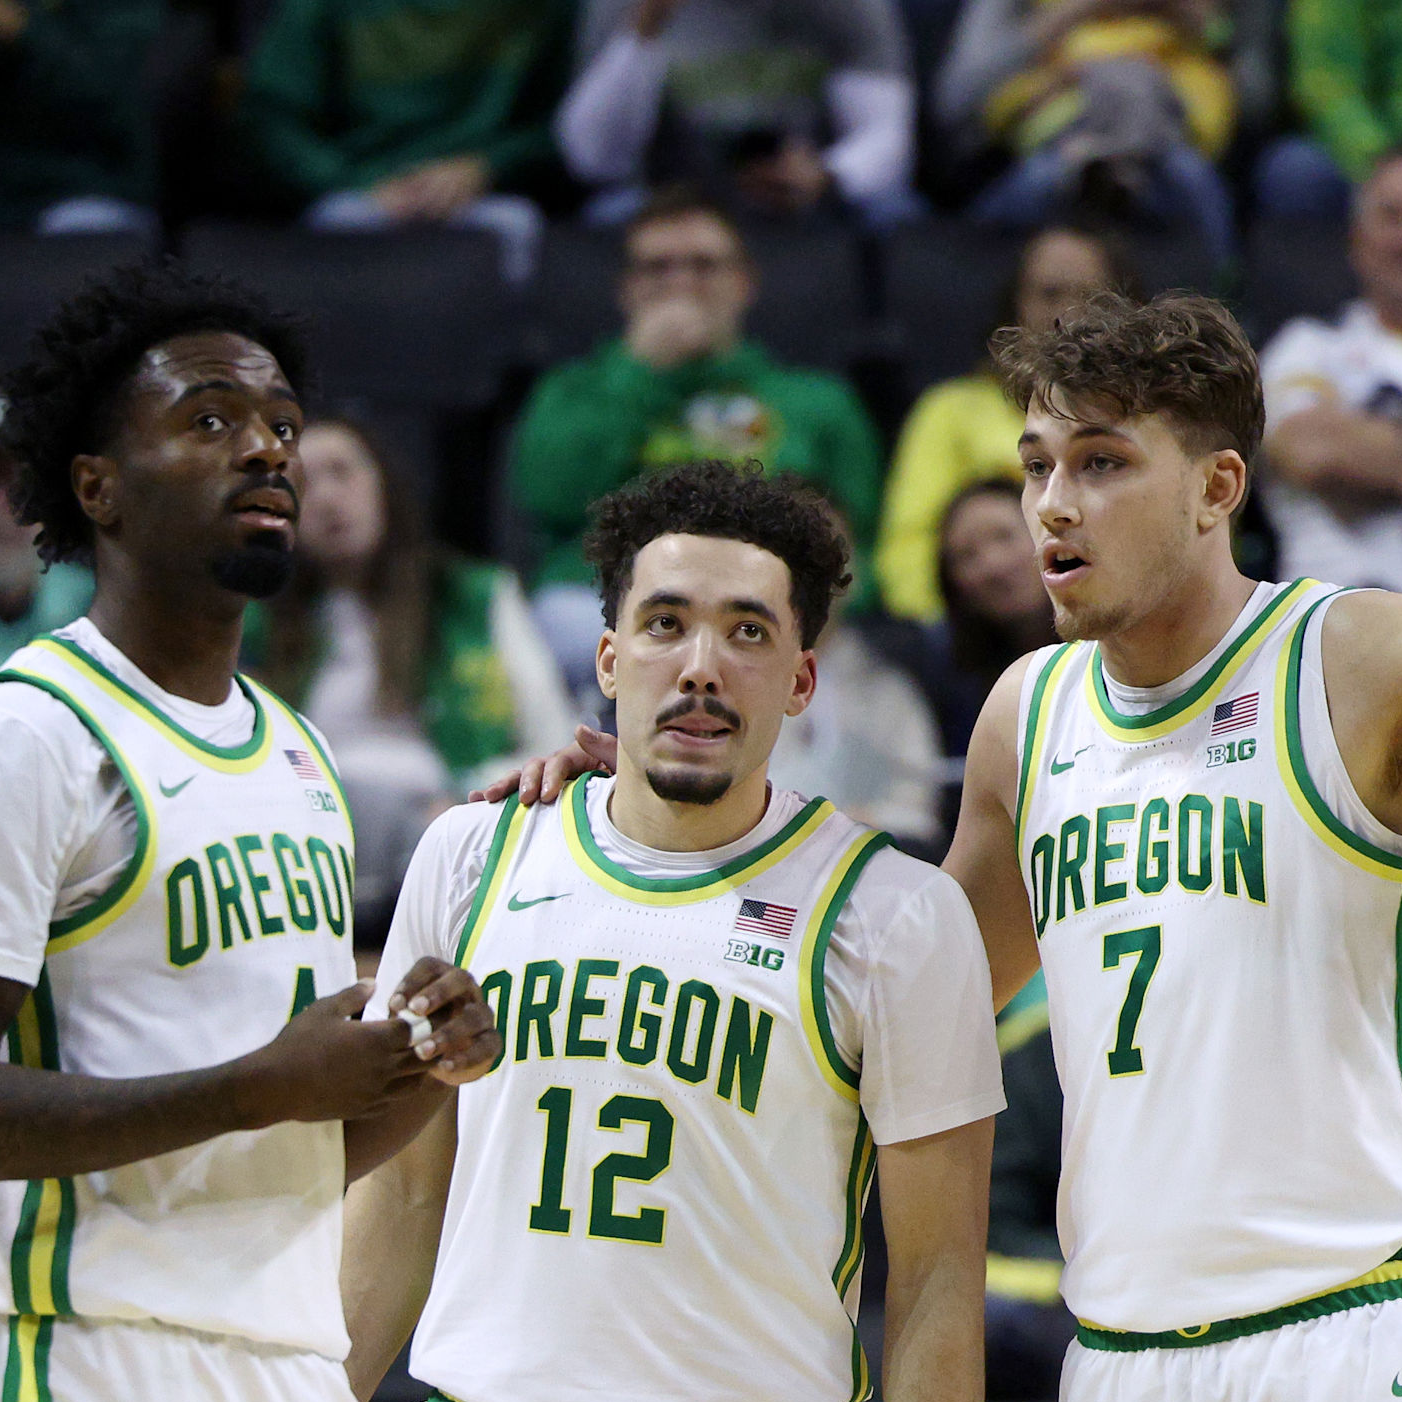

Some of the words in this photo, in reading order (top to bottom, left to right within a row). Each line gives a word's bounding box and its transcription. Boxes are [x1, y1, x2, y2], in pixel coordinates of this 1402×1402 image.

[1031, 794, 1267, 940] OREGON
[1101, 923, 1163, 1078] 7
[528, 1085, 677, 1248] 12
